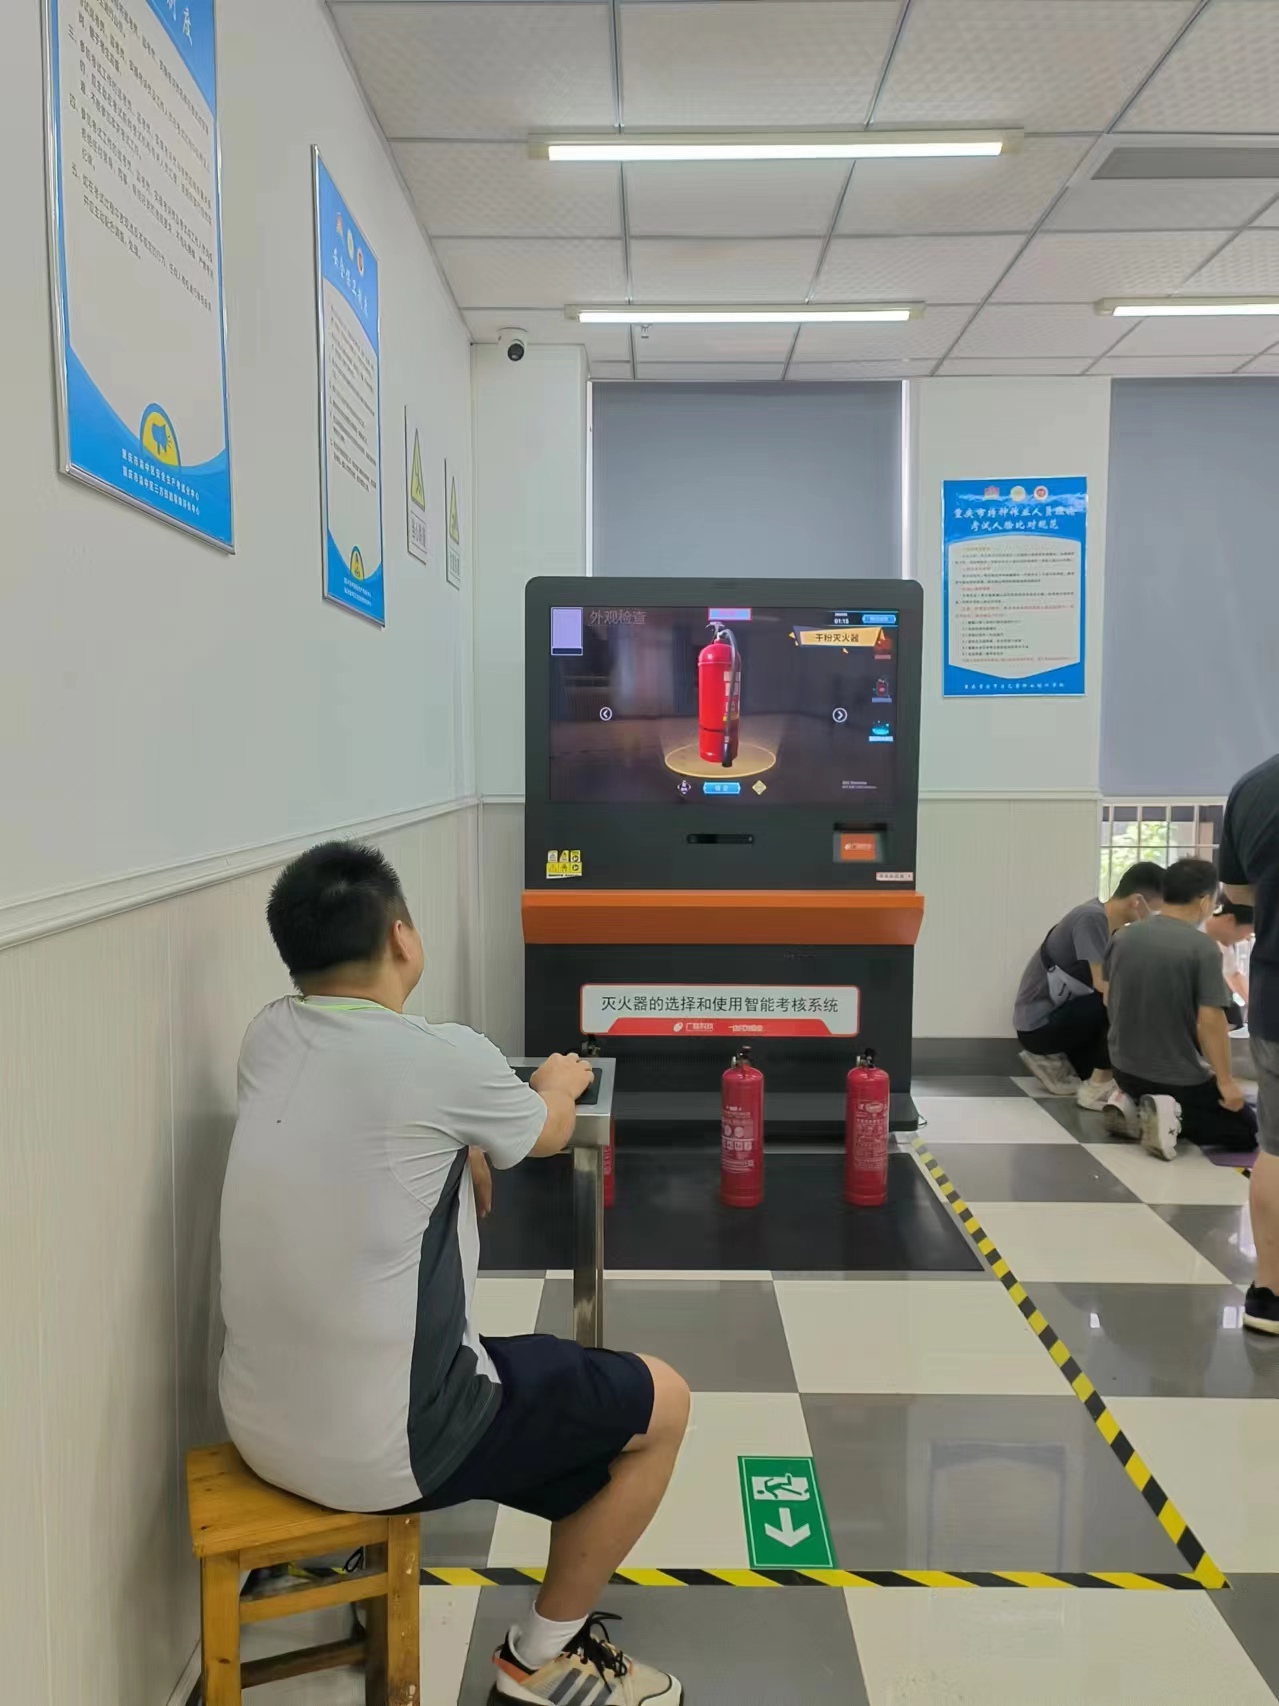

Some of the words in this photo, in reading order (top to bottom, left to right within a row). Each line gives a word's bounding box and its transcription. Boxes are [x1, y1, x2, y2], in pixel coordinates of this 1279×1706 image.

[590, 609, 648, 625] 外观检查
[815, 633, 860, 643] 干粉灭火器
[600, 995, 840, 1013] 灭火器的选择和使用智能考核系统
